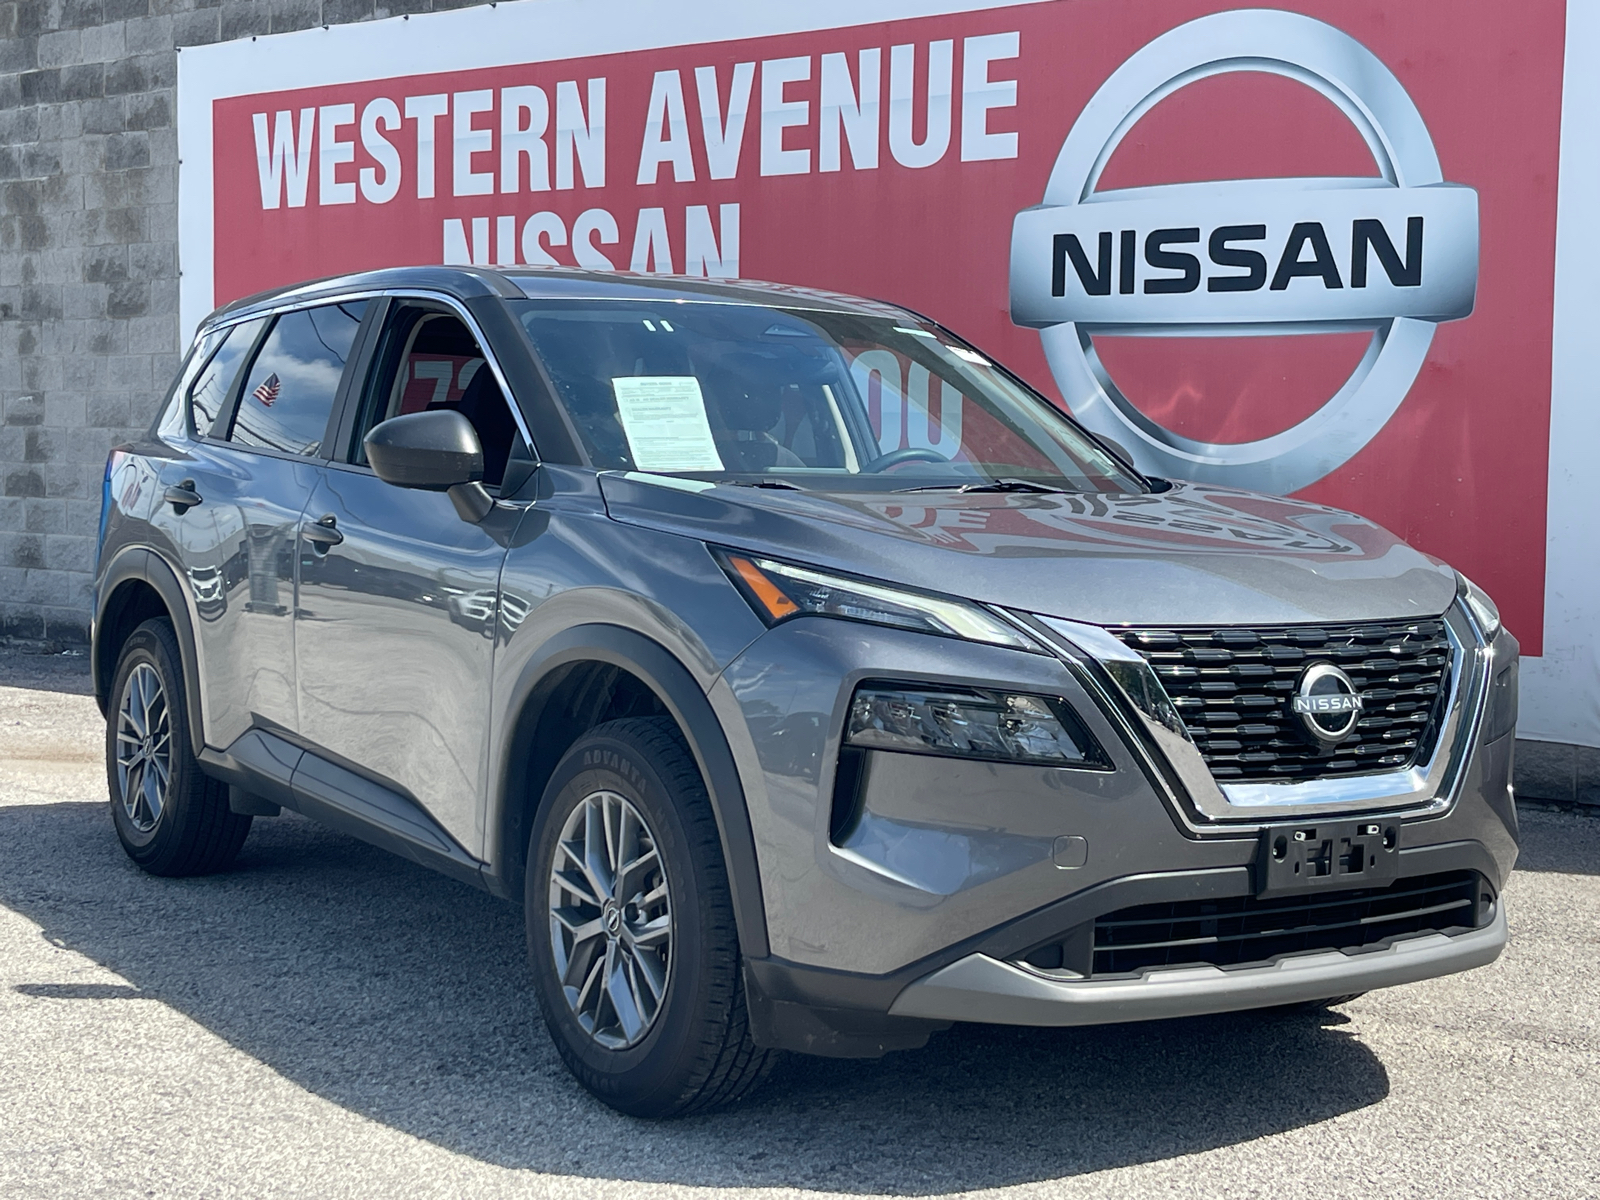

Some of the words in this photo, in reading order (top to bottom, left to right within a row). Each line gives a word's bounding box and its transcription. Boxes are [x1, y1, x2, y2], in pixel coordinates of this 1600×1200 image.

[252, 77, 607, 210] WESTERN
[636, 31, 1021, 186] AVENUE
[1051, 216, 1424, 297] NISSAN
[1296, 695, 1362, 711] NISSAN
[583, 749, 647, 794] ADVANTA
